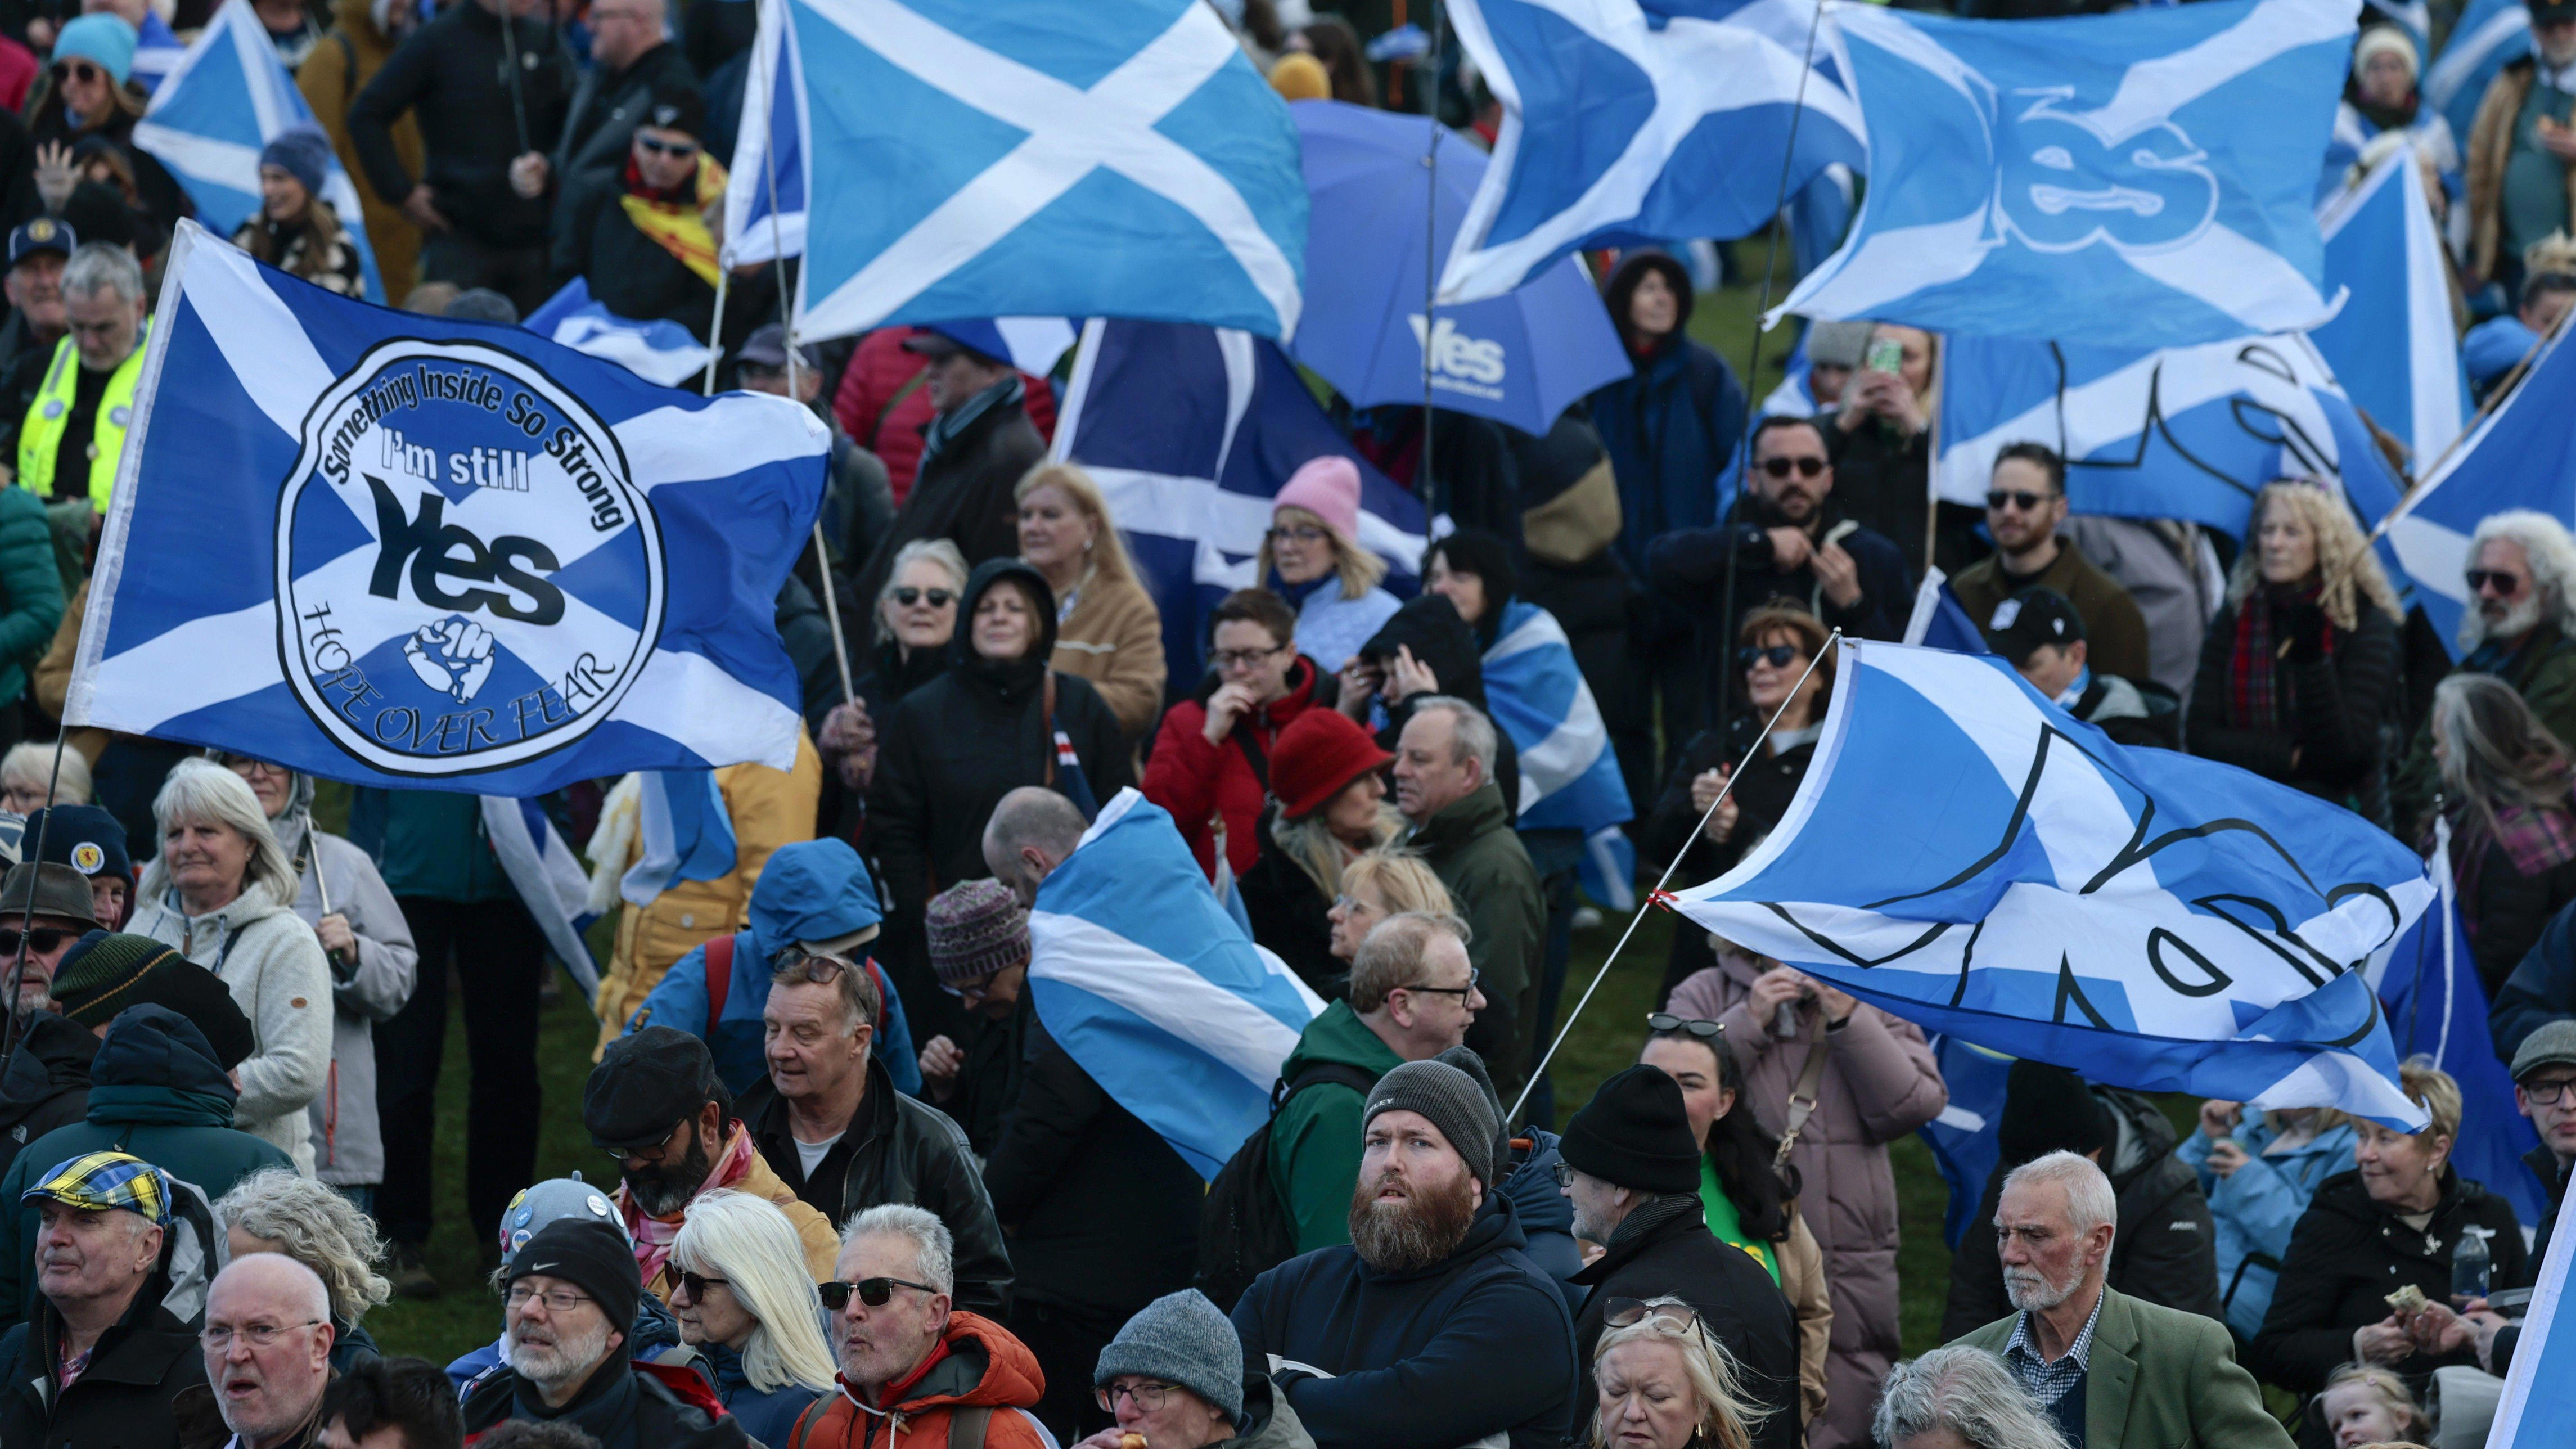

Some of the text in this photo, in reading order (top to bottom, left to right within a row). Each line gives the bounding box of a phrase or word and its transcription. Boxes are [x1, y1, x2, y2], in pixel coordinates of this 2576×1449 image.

[1407, 313, 1506, 385] Yes
[324, 364, 625, 533] Something Inside So Strong
[382, 427, 529, 492] I'm still
[361, 471, 565, 626] Yes
[303, 599, 616, 752] HOPE OVER FEAR
